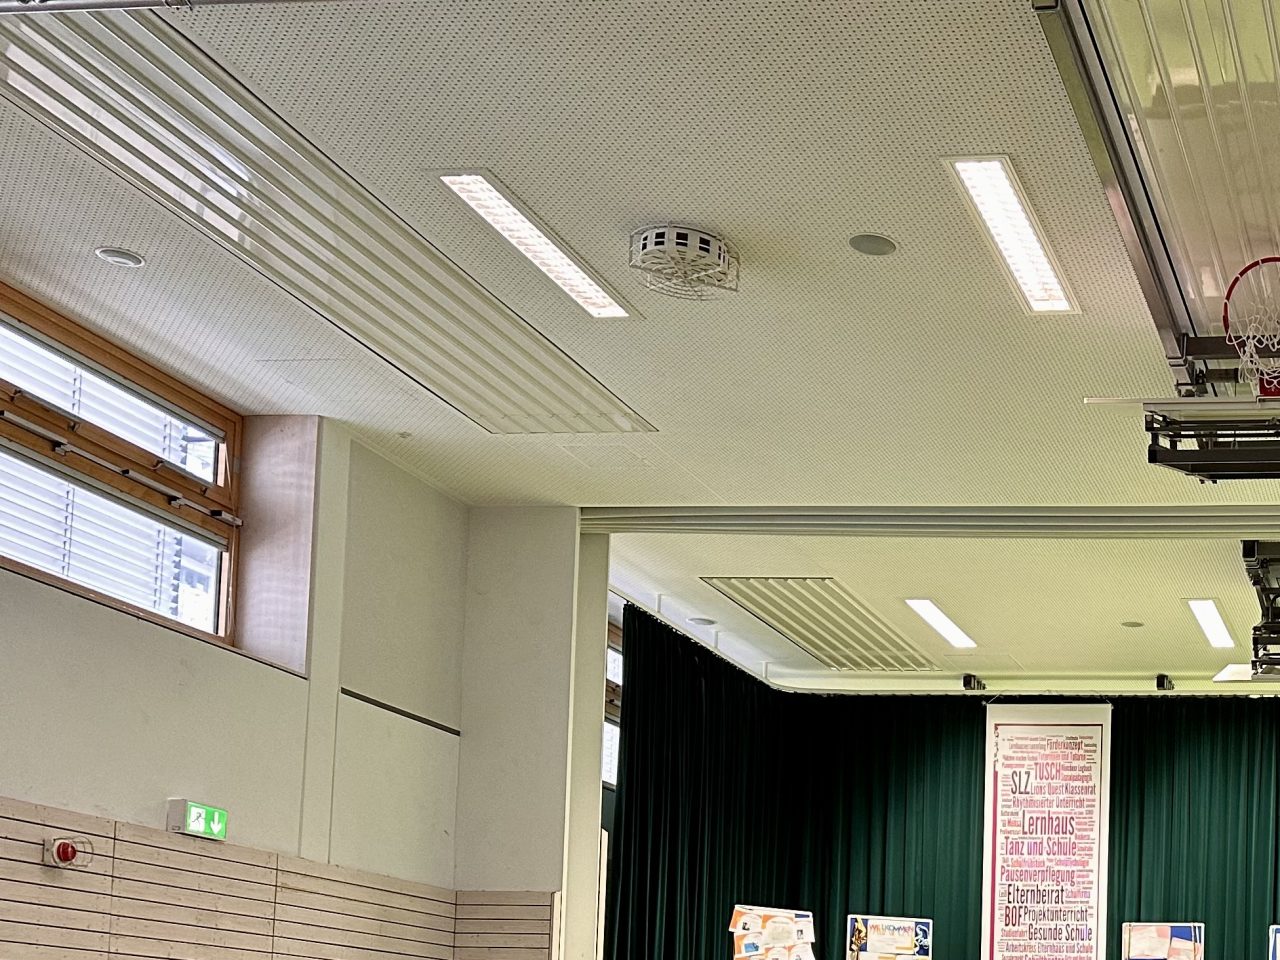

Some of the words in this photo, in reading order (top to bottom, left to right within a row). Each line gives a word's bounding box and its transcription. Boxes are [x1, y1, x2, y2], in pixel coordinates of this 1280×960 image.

[1034, 762, 1061, 780] TUSCH
[1011, 770, 1030, 794] SLZ
[1065, 784, 1096, 795] Klassenrat
[1022, 810, 1074, 835] Lernhaus
[1004, 836, 1024, 856] Tanz
[1027, 837, 1043, 856] und
[1046, 837, 1076, 856] Schule
[1001, 865, 1075, 886] Pausenverpflegung
[1008, 884, 1064, 904] Elternbeirat
[1005, 906, 1023, 926] BOF
[1024, 906, 1088, 924] Projektunterricht
[1029, 924, 1062, 940] Gesunde
[1065, 924, 1092, 941] Schule
